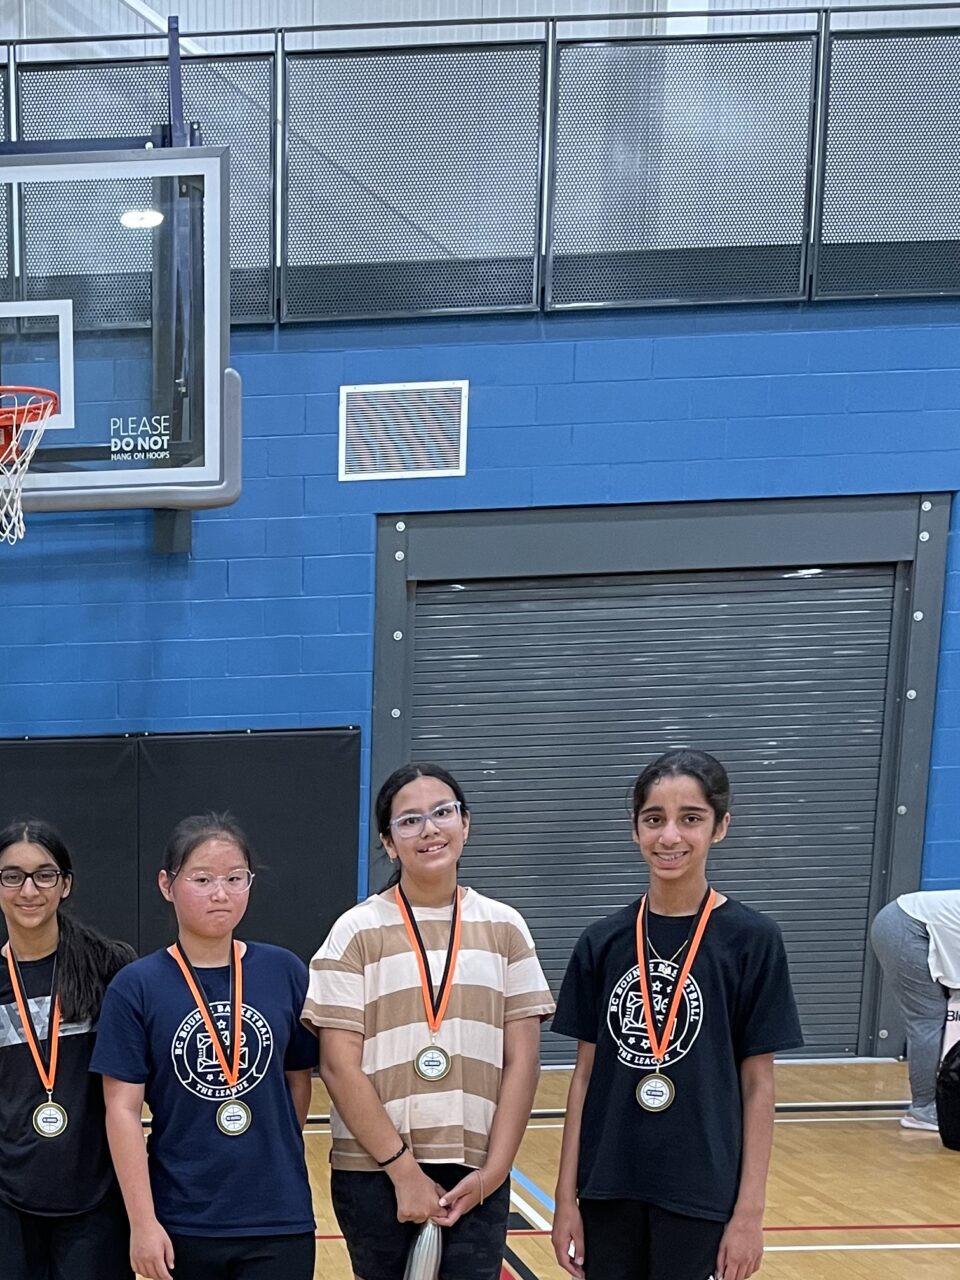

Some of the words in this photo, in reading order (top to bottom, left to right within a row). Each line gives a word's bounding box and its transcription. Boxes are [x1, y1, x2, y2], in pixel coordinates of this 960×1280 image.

[110, 415, 170, 436] PLEASE
[110, 437, 135, 452] DO
[137, 435, 170, 450] NOT
[111, 452, 132, 461] HANG
[133, 452, 145, 460] ON
[146, 450, 170, 460] HOOPS
[610, 997, 619, 1012] BC
[616, 963, 654, 996] BOUNE
[658, 963, 700, 1022] BASETBALL
[945, 1010, 960, 1022] Bl
[175, 1041, 184, 1055] BC
[217, 1004, 271, 1048] BAKETBALL
[617, 1046, 632, 1061] THE
[195, 1083, 213, 1096] THE
